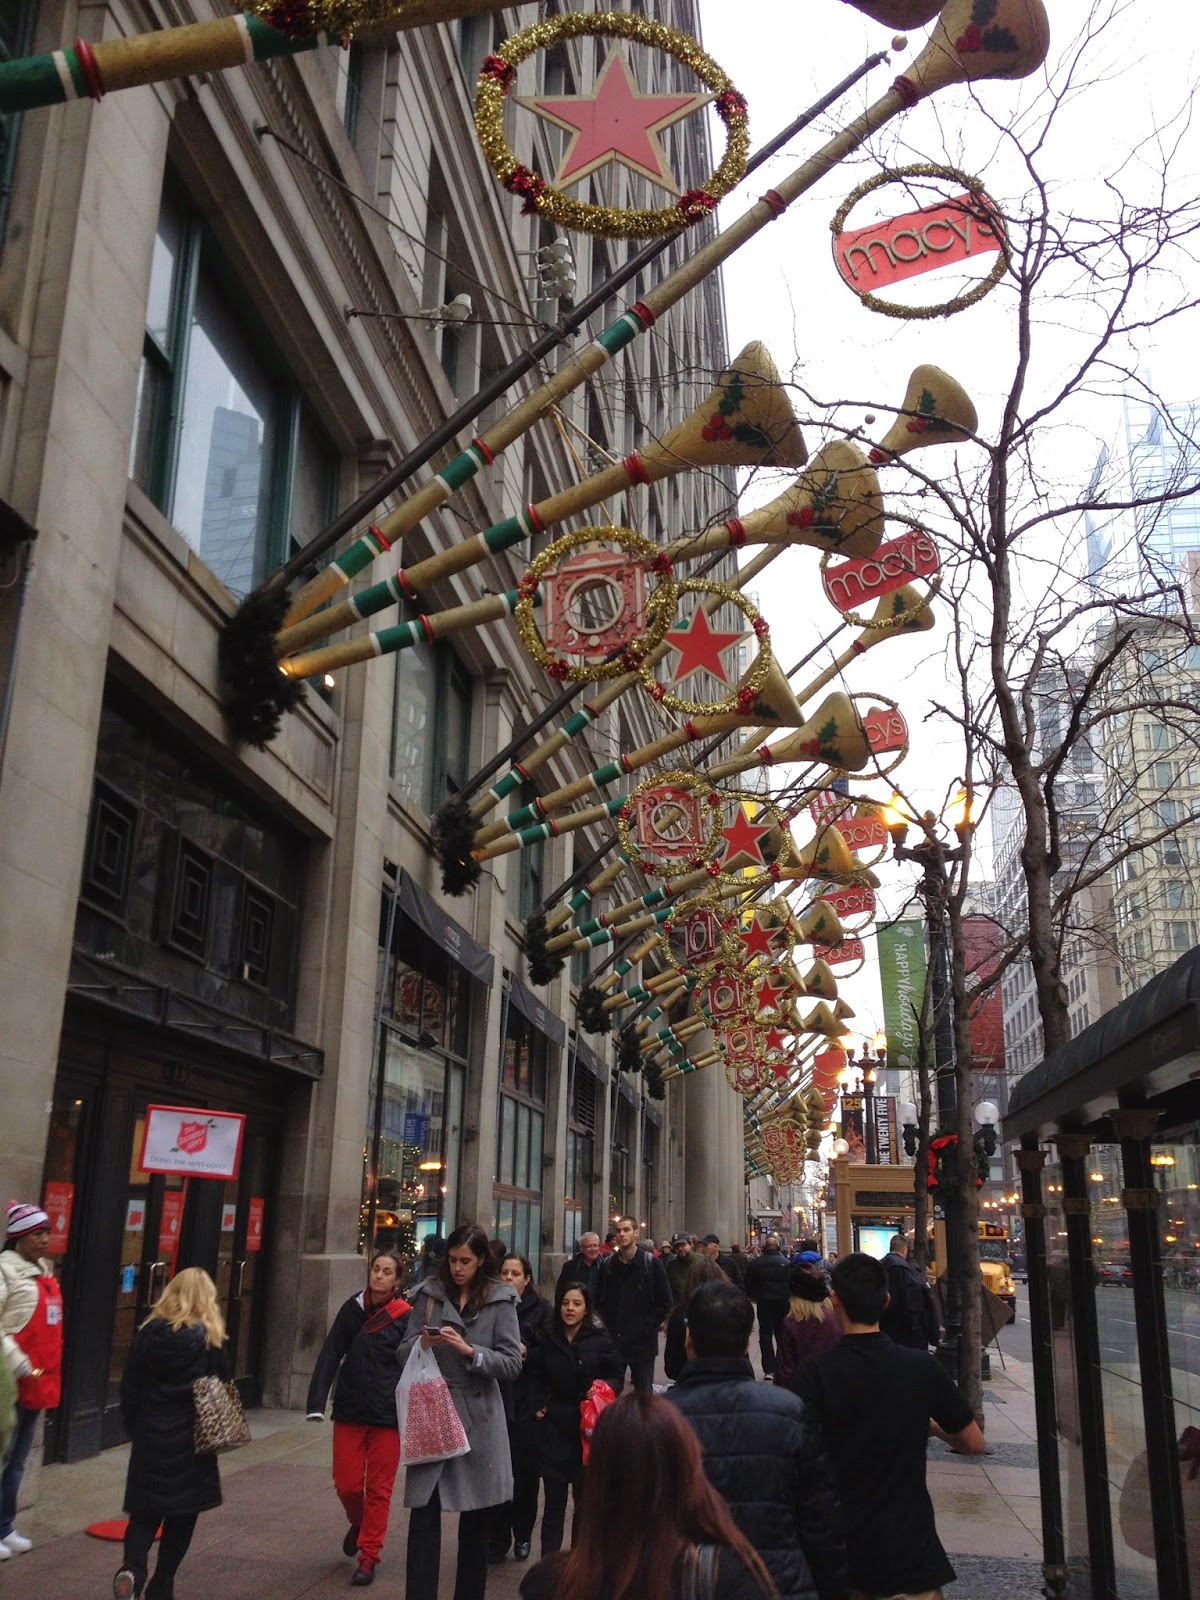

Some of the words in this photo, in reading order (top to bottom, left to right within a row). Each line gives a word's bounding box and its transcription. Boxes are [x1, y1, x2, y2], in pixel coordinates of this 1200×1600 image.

[894, 943, 911, 987] HAPPY
[843, 1098, 861, 1109] 125
[876, 1098, 887, 1116] FIVE
[877, 1117, 889, 1149] TWENTY
